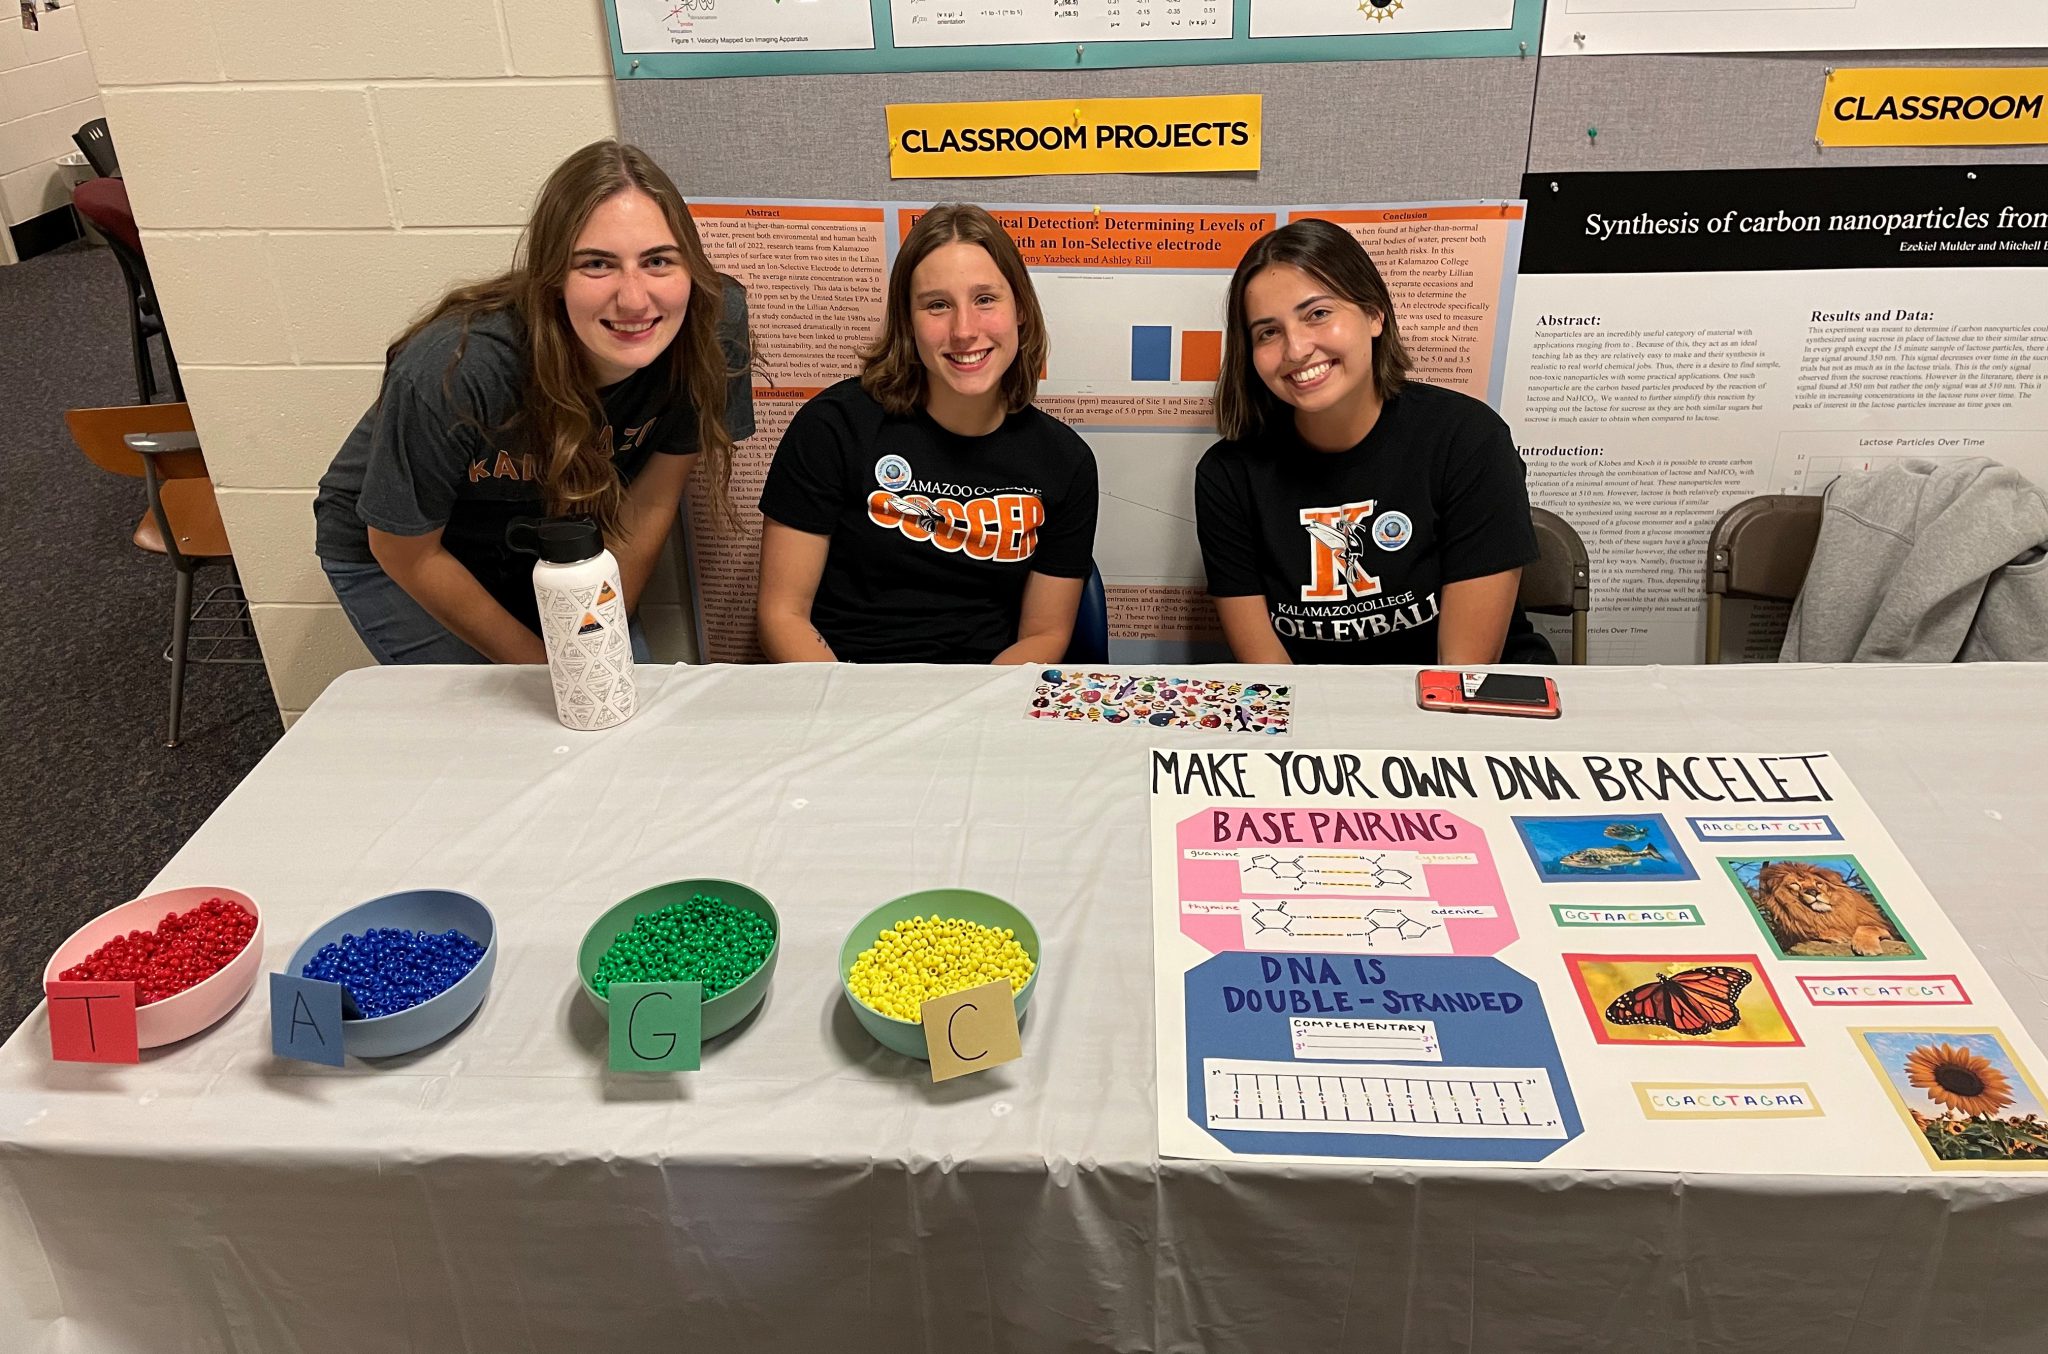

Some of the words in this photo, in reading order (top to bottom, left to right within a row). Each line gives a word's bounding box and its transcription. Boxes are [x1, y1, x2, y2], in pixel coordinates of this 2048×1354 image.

[1833, 95, 2044, 121] CLASSROOM
[901, 125, 1087, 153] CLASSROOM
[1096, 122, 1248, 149] PROJECTS
[744, 208, 780, 218] Abstract
[1382, 211, 1428, 221] Conclusion
[1028, 216, 1100, 230] Detection:
[1104, 217, 1194, 234] Determining
[1200, 218, 1245, 232] Levels
[1249, 218, 1265, 232] of
[1355, 227, 1375, 235] when
[1377, 226, 1398, 234] found
[1408, 223, 1478, 234] higher-than-normal
[1586, 211, 1700, 240] Synthesis
[1706, 208, 1737, 232] of
[1738, 210, 1822, 232] carbon
[1828, 206, 1990, 236] nanoparticles
[1040, 240, 1058, 249] an
[1062, 237, 1152, 250] Ion-Selective
[1156, 238, 1222, 252] electrode
[1382, 236, 1406, 245] bodies
[1468, 235, 1486, 243] both
[1900, 242, 1937, 251] Ezekiel
[1939, 241, 1976, 251] Mulder
[1978, 241, 1996, 251] and
[1998, 240, 2041, 250] Mitchell
[1386, 247, 1408, 255] health
[1440, 246, 1454, 254] this
[1043, 254, 1080, 265] Yazbeck
[1083, 254, 1099, 264] and
[1101, 254, 1132, 266] Ashley
[1397, 257, 1438, 265] Kalamazoo
[1440, 257, 1468, 267] College
[1422, 269, 1447, 278] nearby
[1536, 314, 1601, 326] Abstract:
[1810, 310, 1860, 322] Results
[1864, 310, 1891, 321] and
[1895, 310, 1935, 321] Data:
[1534, 329, 1582, 339] Nanoparticles
[1606, 330, 1641, 339] incredibly
[1416, 344, 1457, 352] determined
[1076, 396, 1098, 406] (ppm)
[1100, 396, 1134, 404] measured
[1134, 396, 1145, 404] of
[1144, 396, 1160, 405] Site
[1167, 396, 1181, 405] and
[1182, 397, 1197, 405] Site
[1045, 408, 1061, 417] ppm
[1895, 437, 1934, 446] Particles
[1962, 438, 1984, 446] Time
[1278, 602, 1357, 617] KALAMAZOO
[1356, 591, 1416, 612] COLLEGE
[1152, 750, 1256, 798] MAKE
[1265, 751, 1379, 798] YOUR
[1382, 756, 1478, 798] OWN
[1484, 755, 1581, 800] DNA
[1582, 754, 1834, 802] BRACELET
[1213, 810, 1304, 843] BASE
[1308, 812, 1458, 842] PAIRING
[1188, 903, 1240, 913] thymine
[1260, 956, 1342, 986] DNA
[1356, 958, 1386, 984] IS
[1222, 986, 1354, 1014] DOUBLE
[1382, 989, 1524, 1014] STRANDED
[54, 995, 120, 1053] T
[290, 991, 326, 1046] A
[628, 992, 676, 1061] G
[948, 1003, 988, 1061] C
[1294, 1019, 1426, 1034] COMPLEMENTARY
